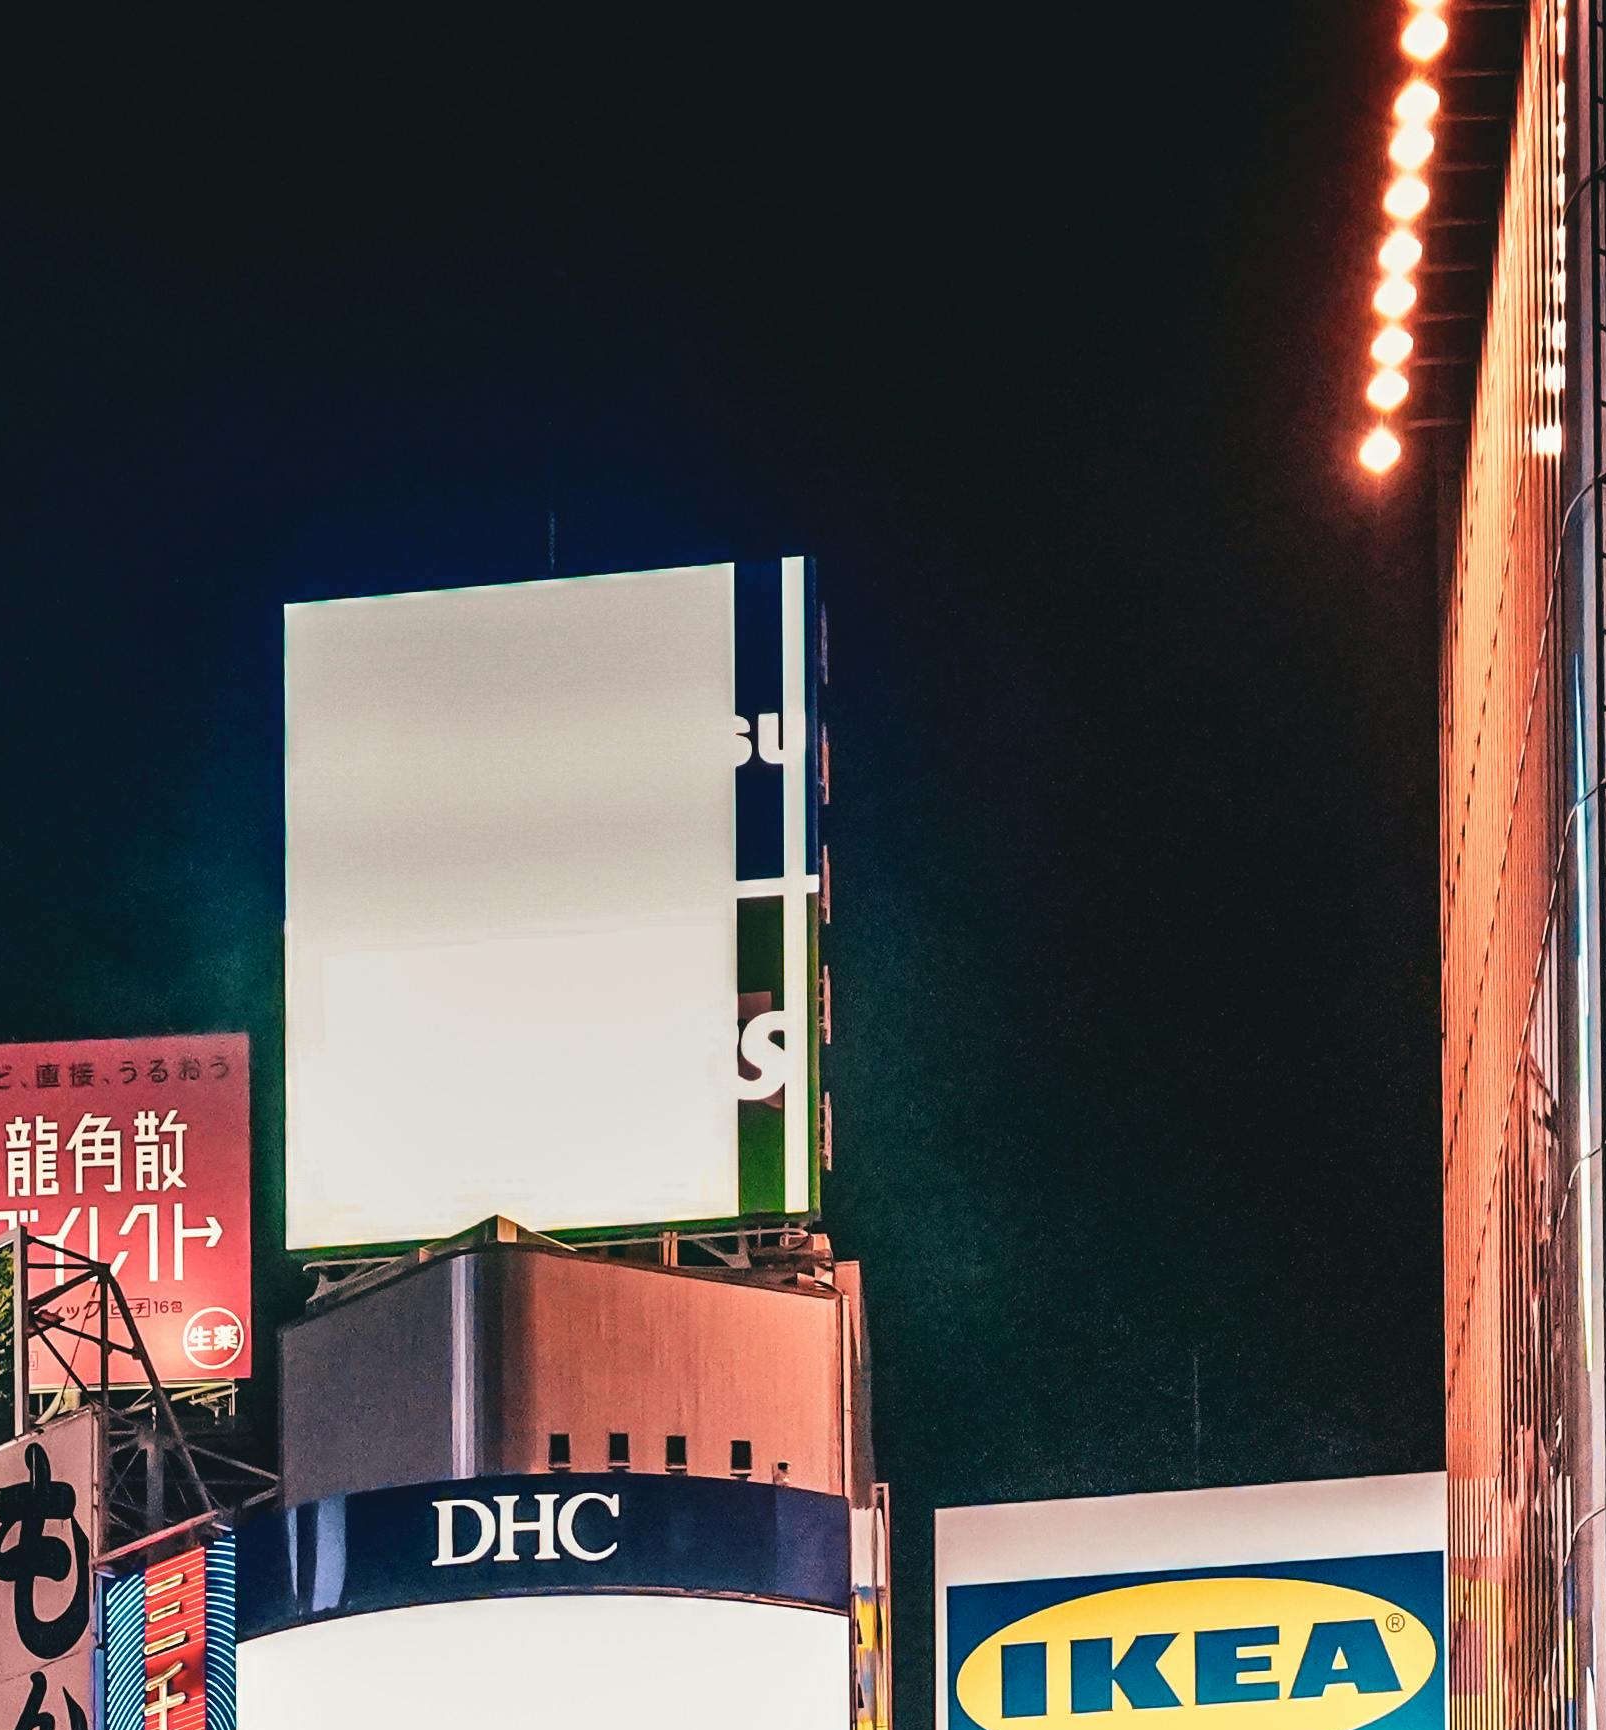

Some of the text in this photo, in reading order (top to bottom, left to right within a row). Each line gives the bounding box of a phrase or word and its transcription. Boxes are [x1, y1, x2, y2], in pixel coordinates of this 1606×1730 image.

[5, 1109, 189, 1199] 龍角散
[152, 1299, 184, 1315] 16包
[188, 1321, 240, 1354] 生薬
[431, 1492, 620, 1567] DHC
[1001, 1618, 1403, 1719] IKEA
